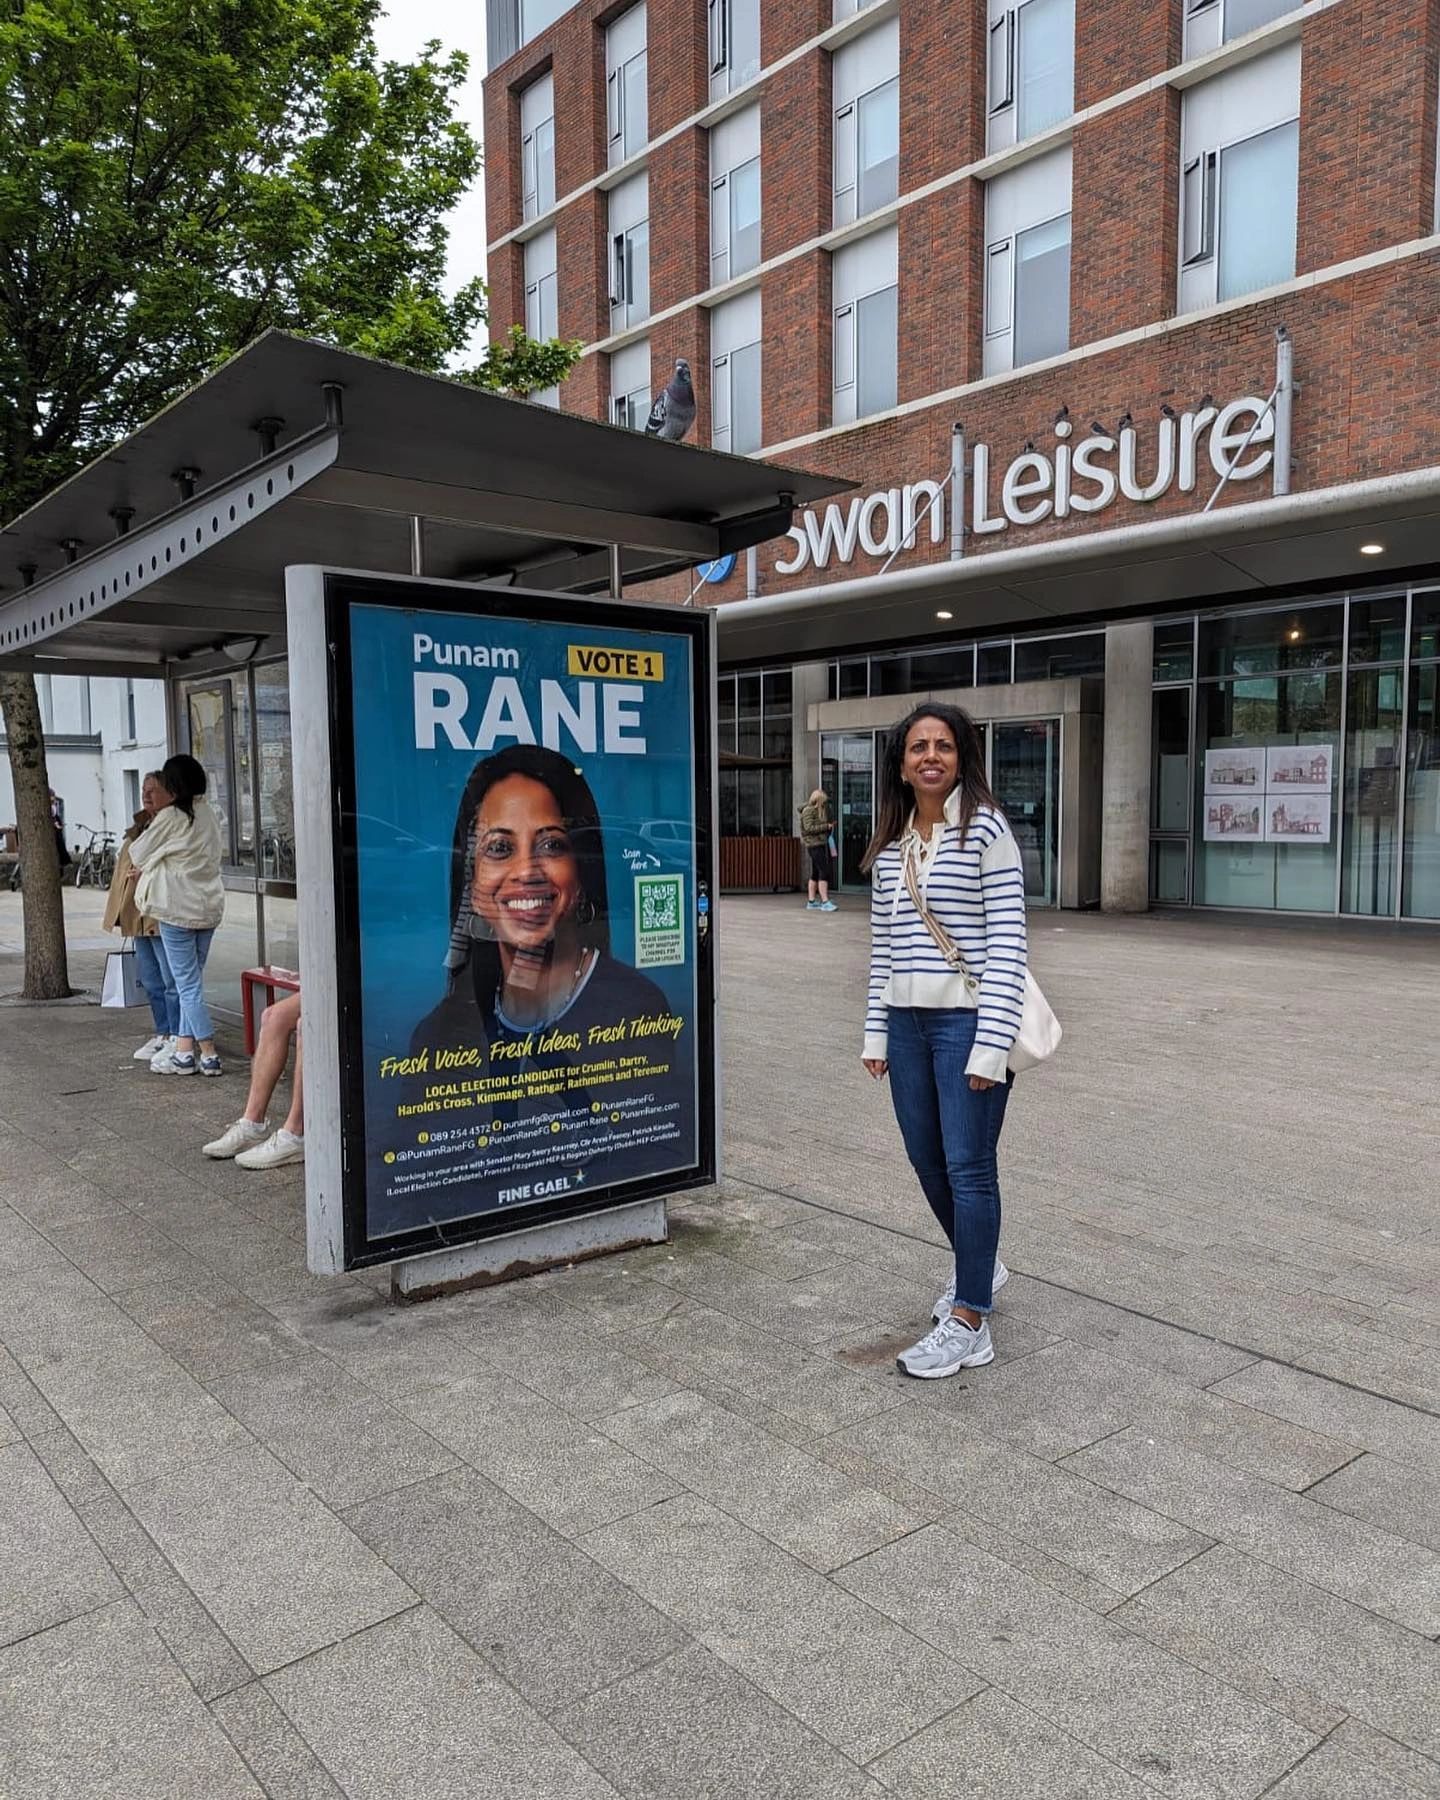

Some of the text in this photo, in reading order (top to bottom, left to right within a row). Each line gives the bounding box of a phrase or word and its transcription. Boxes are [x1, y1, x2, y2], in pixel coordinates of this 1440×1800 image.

[973, 396, 1275, 534] Leisure
[413, 633, 519, 669] Punam
[576, 650, 655, 677] VOTE 1
[413, 671, 647, 754] RANE
[622, 848, 641, 859] Scan
[630, 857, 648, 870] here
[380, 1012, 685, 1079] Fresh Voice, Fresh Ideas, Fresh Thinking
[397, 1064, 670, 1117] Harold's Cross, Kimmage, Rathgar, Rathmines and Terenure
[425, 1055, 648, 1098] LOCAL ELECTION CANDIDATE for Crumlin, Dartry,
[396, 1101, 680, 1161] @PunamRaneFG PunamRaneFG Punam Rane PunamRane.com
[430, 1093, 655, 1142] 089 254 4372 punamfg@gmail.com PunamRaneFG
[394, 1172, 426, 1183] Working
[434, 1167, 452, 1177] your
[486, 1154, 513, 1166] Senator
[514, 1151, 531, 1160] Mary
[411, 1180, 441, 1191] Election
[498, 1177, 571, 1204] FINE GAEL
